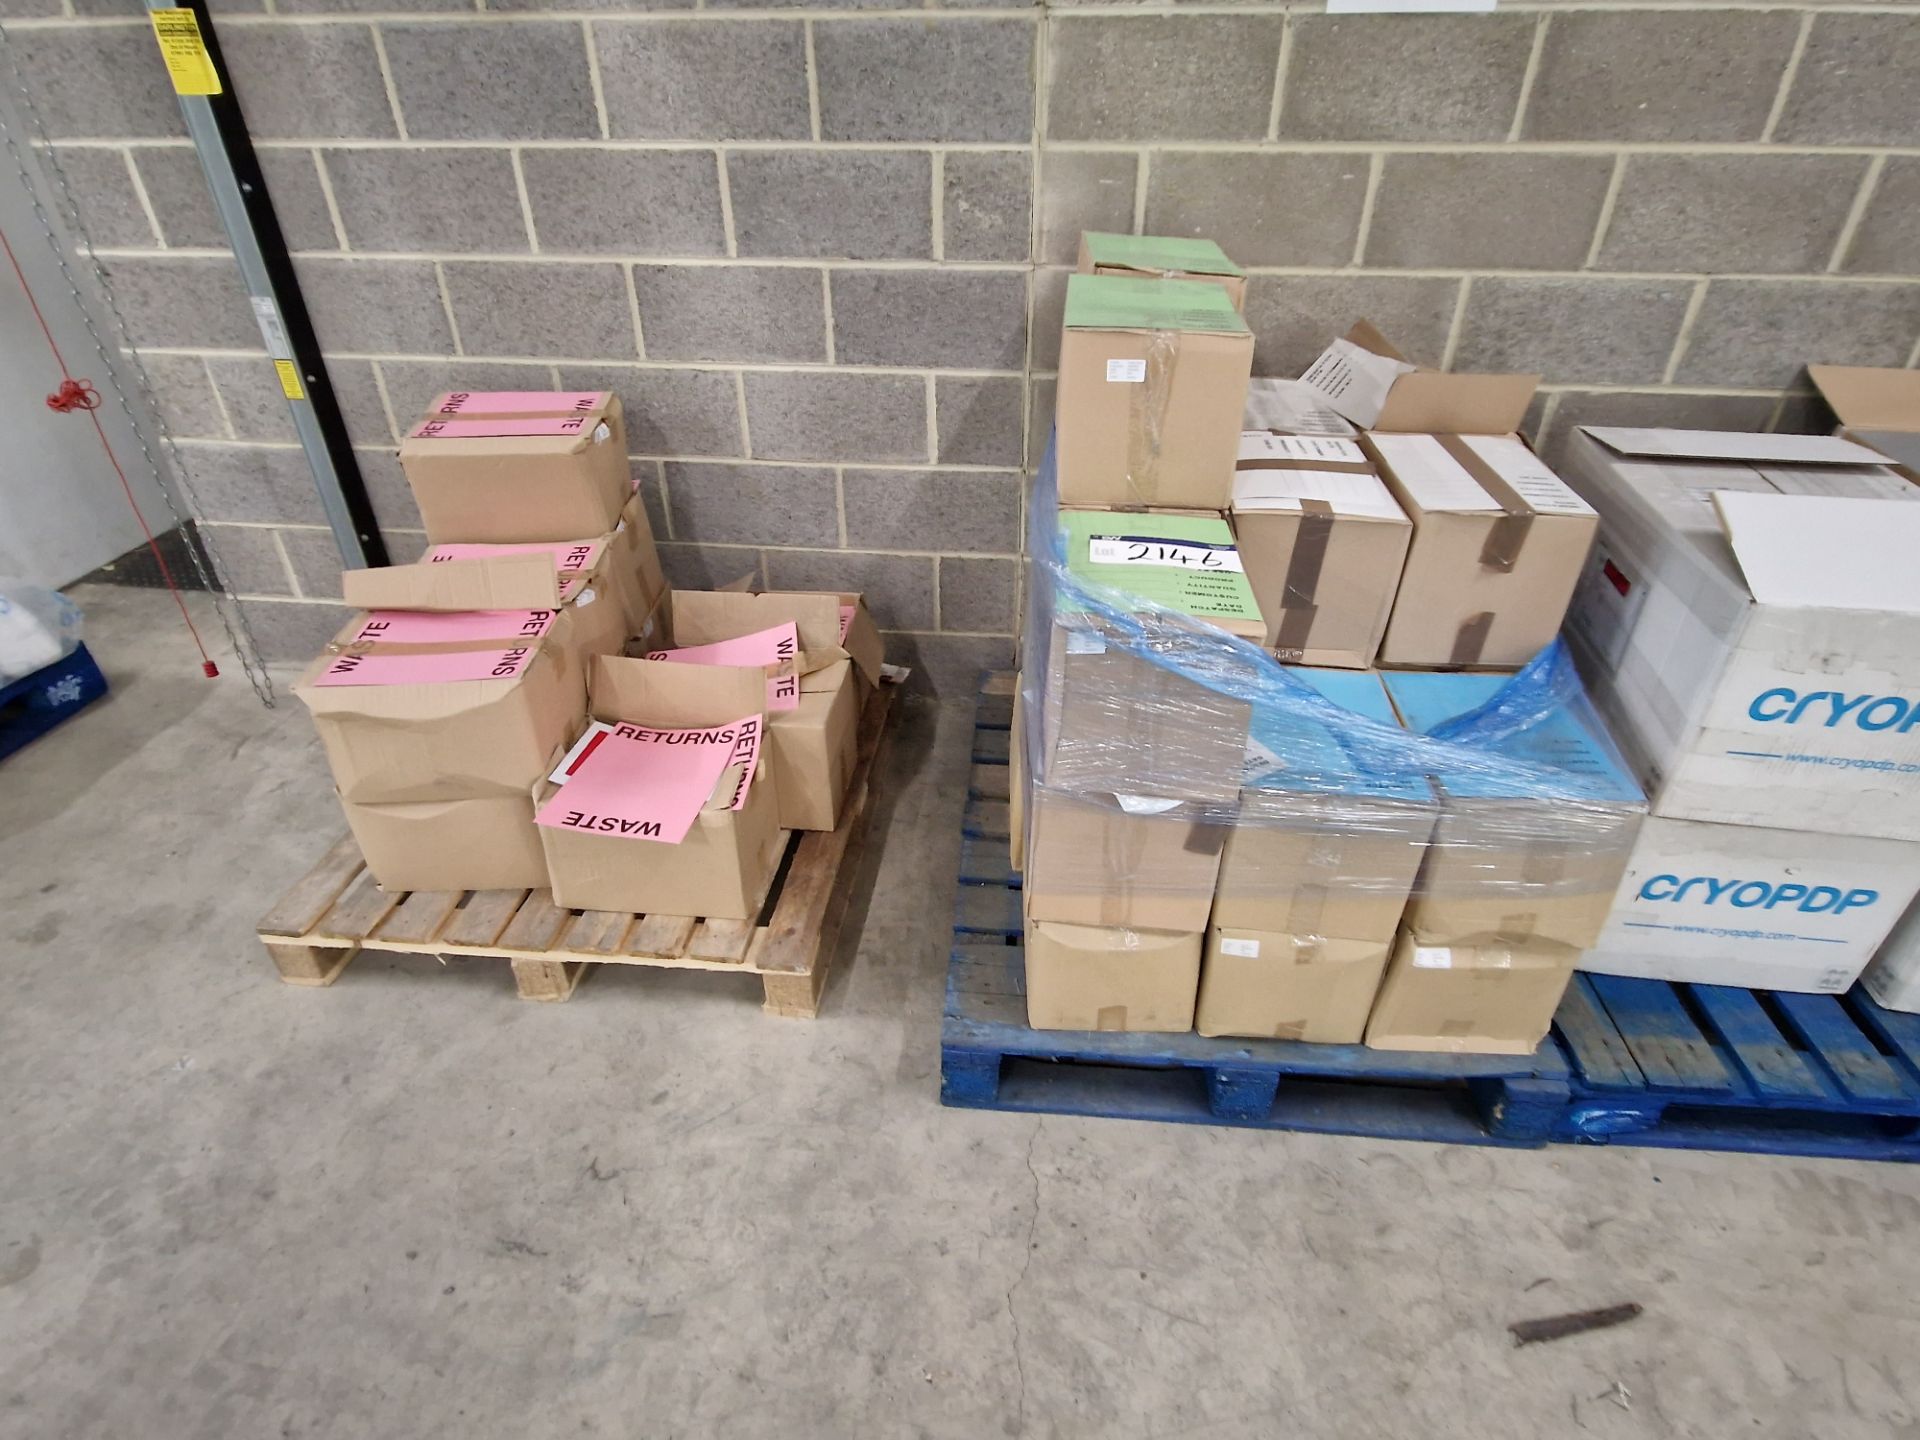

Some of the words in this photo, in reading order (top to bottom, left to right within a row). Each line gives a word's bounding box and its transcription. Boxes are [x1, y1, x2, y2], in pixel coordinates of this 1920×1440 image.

[418, 392, 470, 437] RETRNS
[561, 398, 595, 429] WATE
[1094, 545, 1115, 557] Lot
[1127, 543, 1224, 567] 2146
[558, 546, 591, 597] RETU
[1184, 590, 1240, 600] CUSTOMER
[1190, 604, 1244, 614] DESPATCH
[615, 725, 735, 745] RETURNS
[561, 810, 662, 837] WASTE
